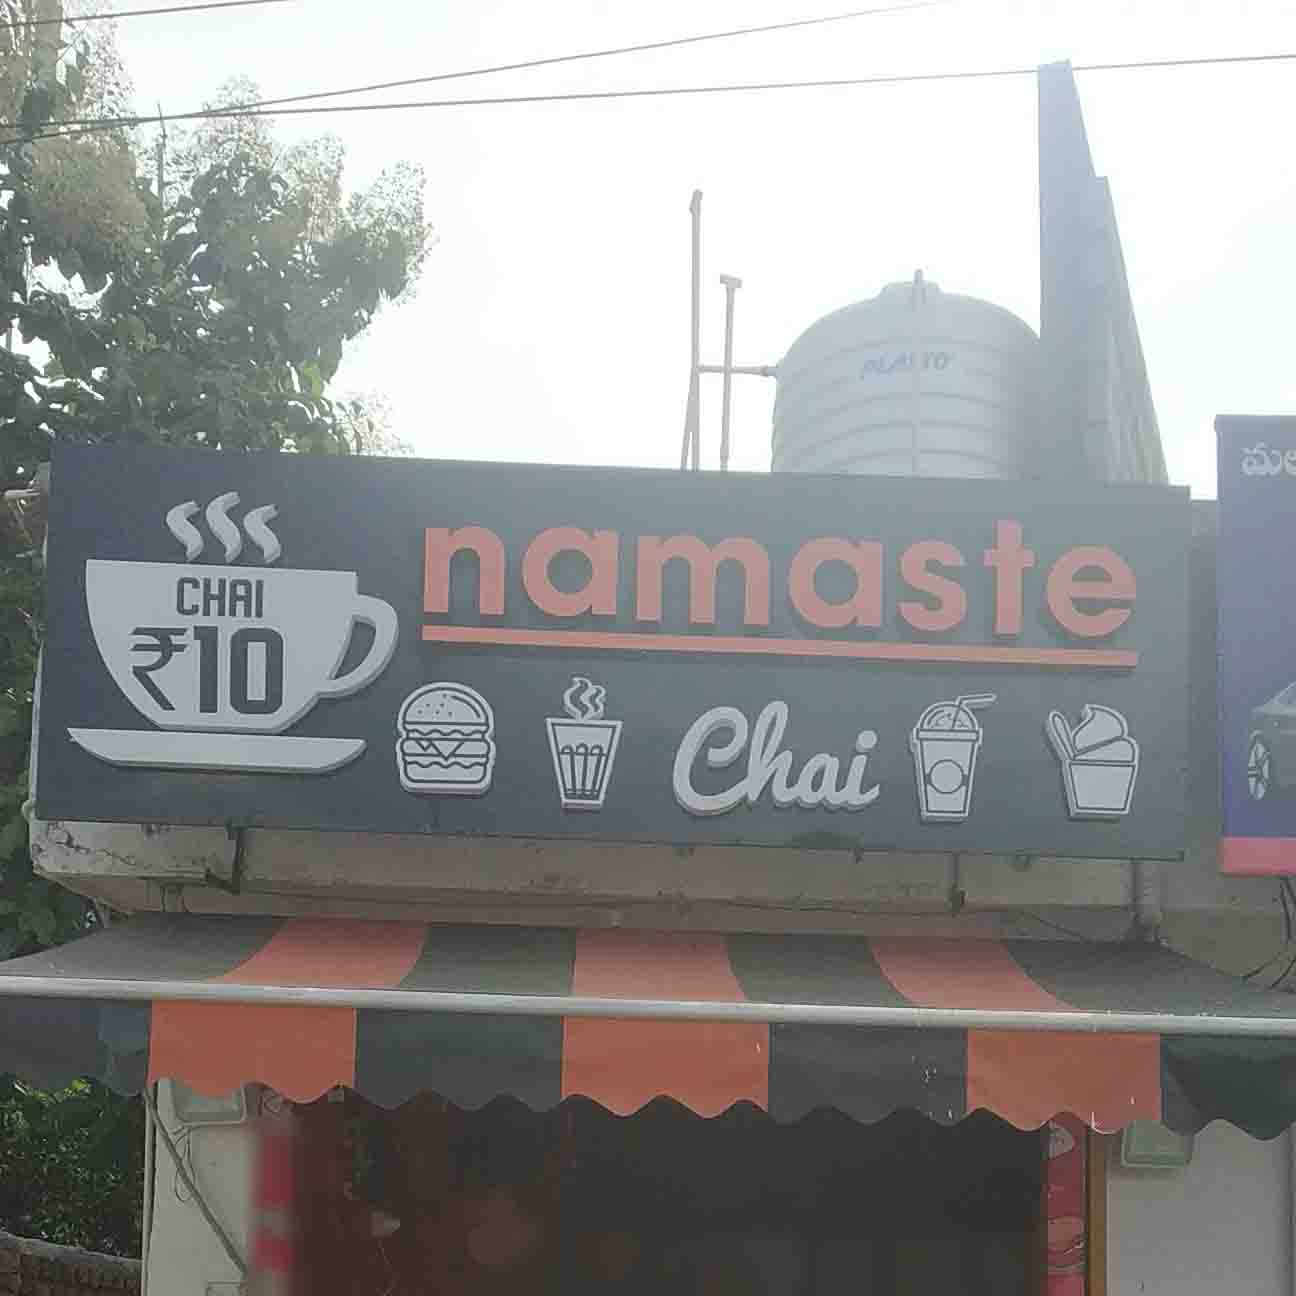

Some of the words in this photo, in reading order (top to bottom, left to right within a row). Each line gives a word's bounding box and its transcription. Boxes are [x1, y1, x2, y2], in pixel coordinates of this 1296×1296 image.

[859, 351, 953, 381] PLATO
[176, 577, 265, 619] CHAI
[423, 519, 1138, 638] namaste
[131, 626, 285, 716] ₹10
[672, 700, 881, 818] Chai
